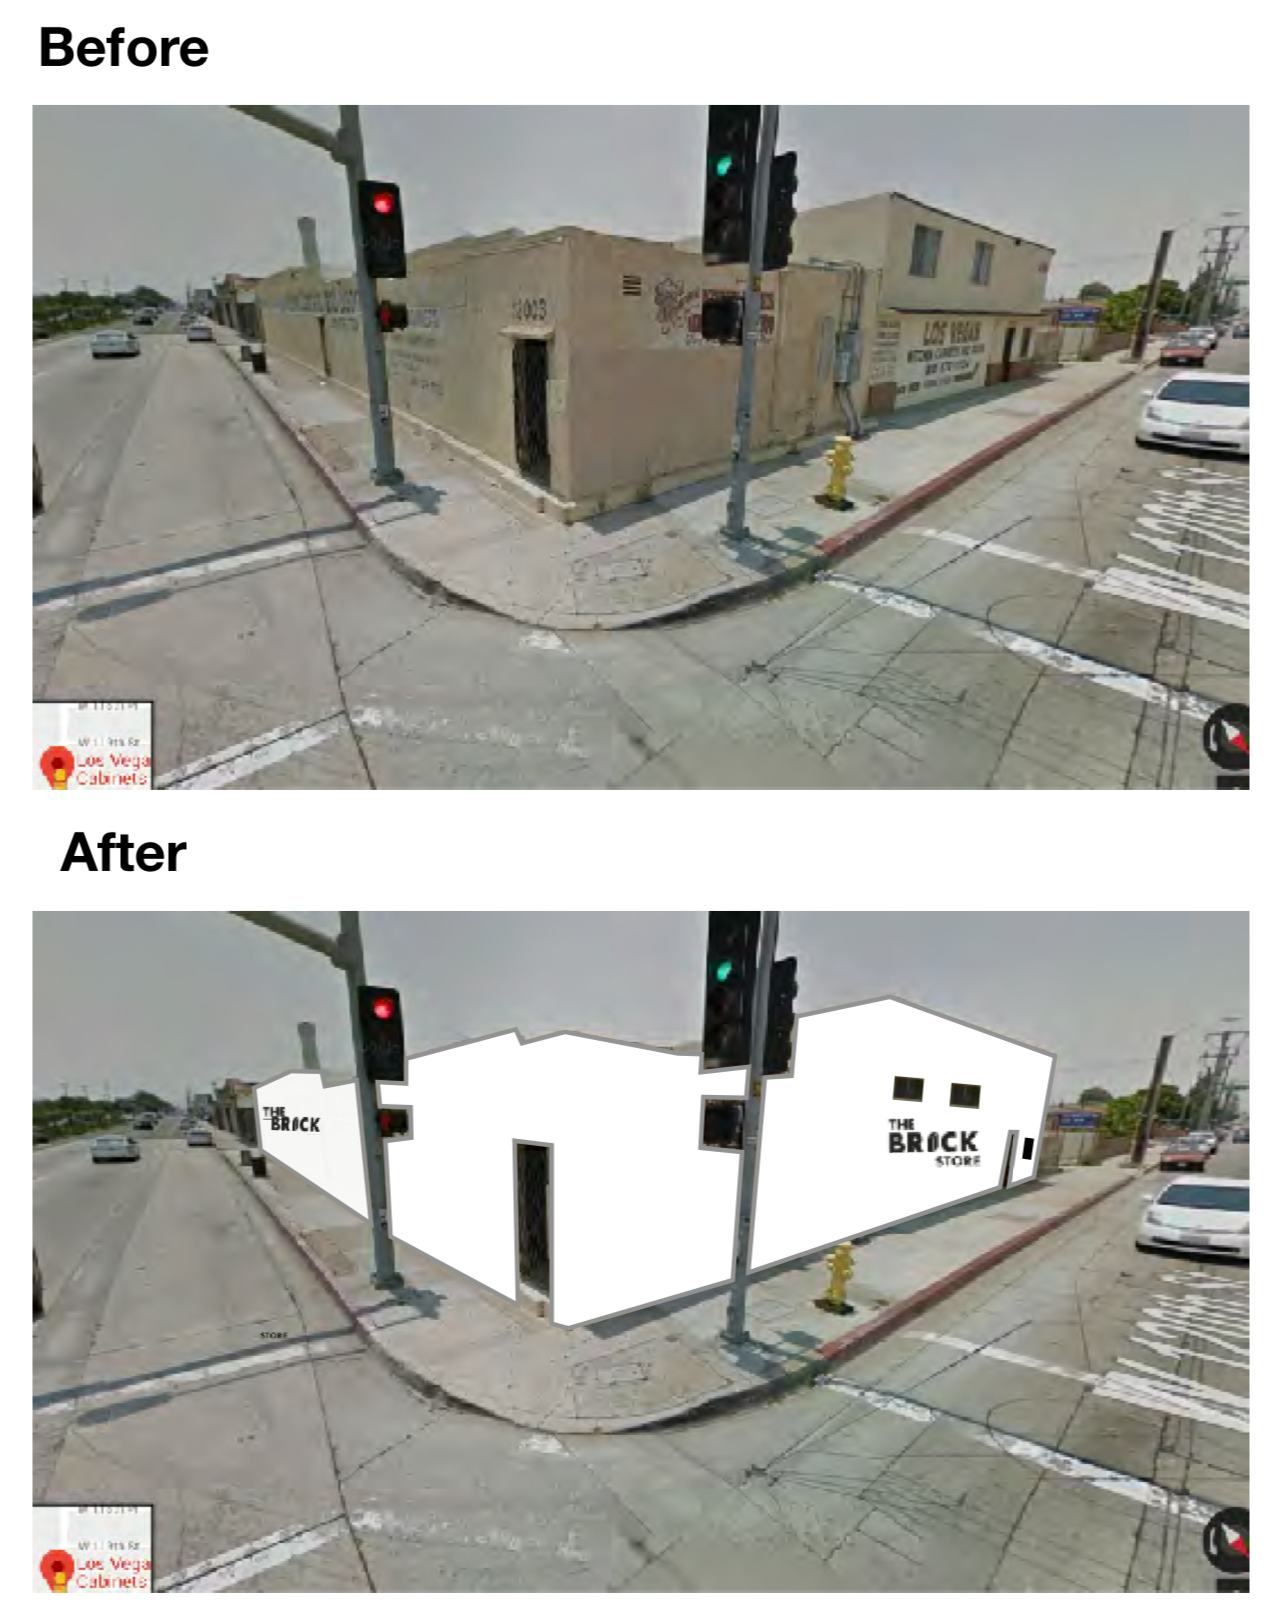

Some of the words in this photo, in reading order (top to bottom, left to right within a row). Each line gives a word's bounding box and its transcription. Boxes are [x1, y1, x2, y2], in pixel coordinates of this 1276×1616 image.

[263, 1107, 285, 1117] THE
[271, 1116, 320, 1132] BRICK
[888, 1118, 915, 1131] THE
[889, 1131, 979, 1153] BRICK
[935, 1155, 981, 1168] STORE
